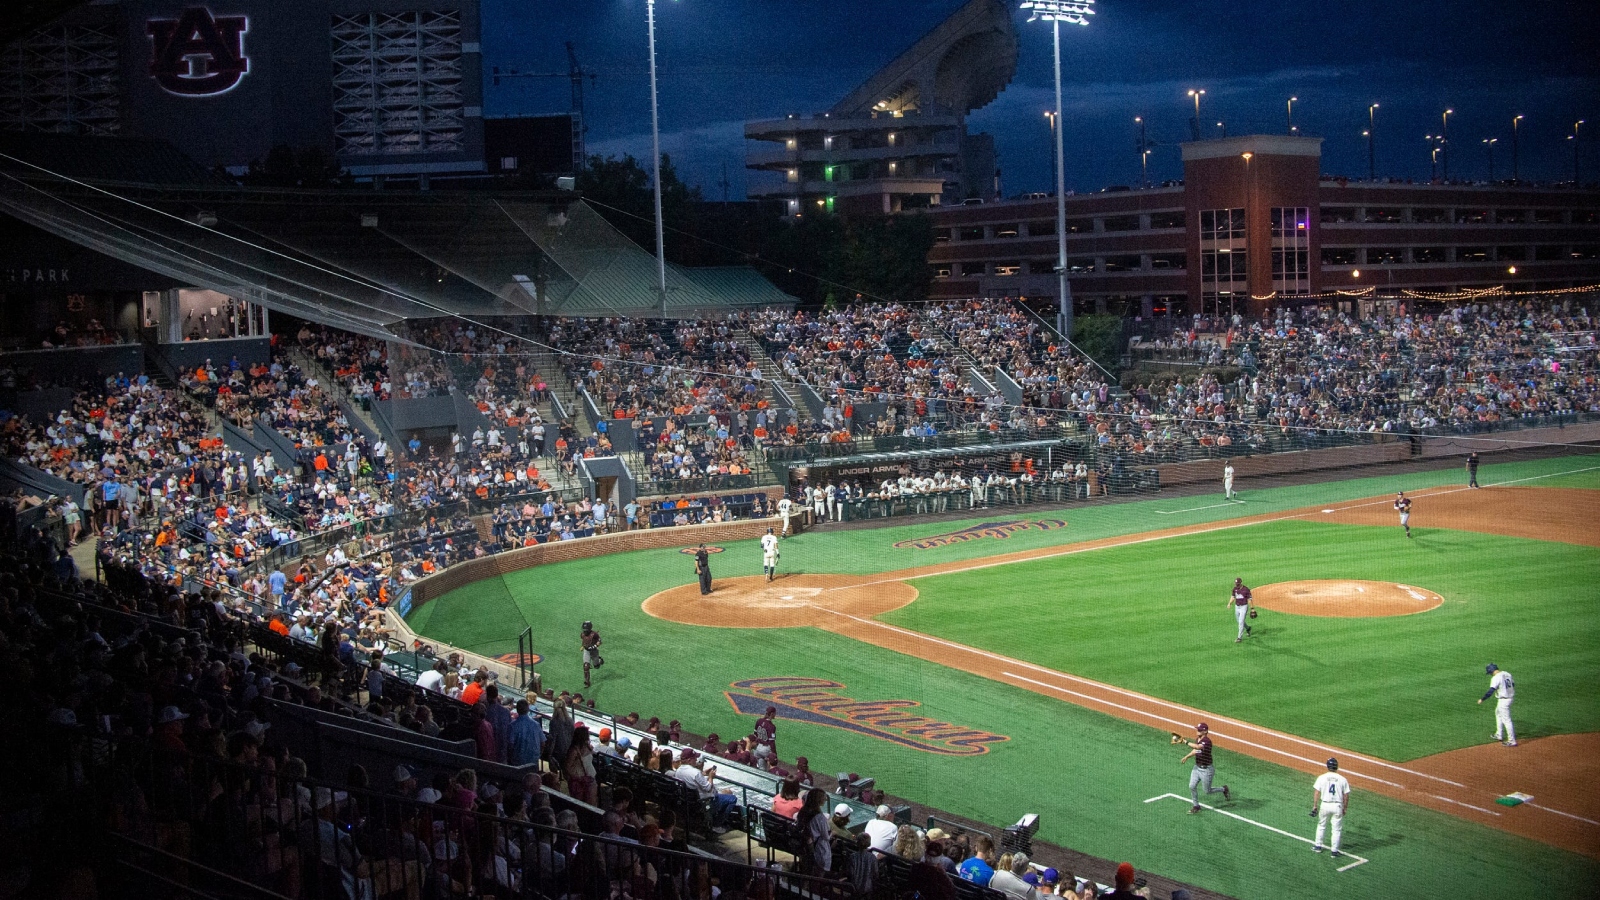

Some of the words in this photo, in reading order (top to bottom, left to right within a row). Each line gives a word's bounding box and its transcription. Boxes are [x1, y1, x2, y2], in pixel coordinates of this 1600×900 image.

[22, 268, 69, 281] PARK
[838, 467, 870, 475] UNDER
[723, 676, 1011, 756] Auburn
[1328, 783, 1336, 796] 4
